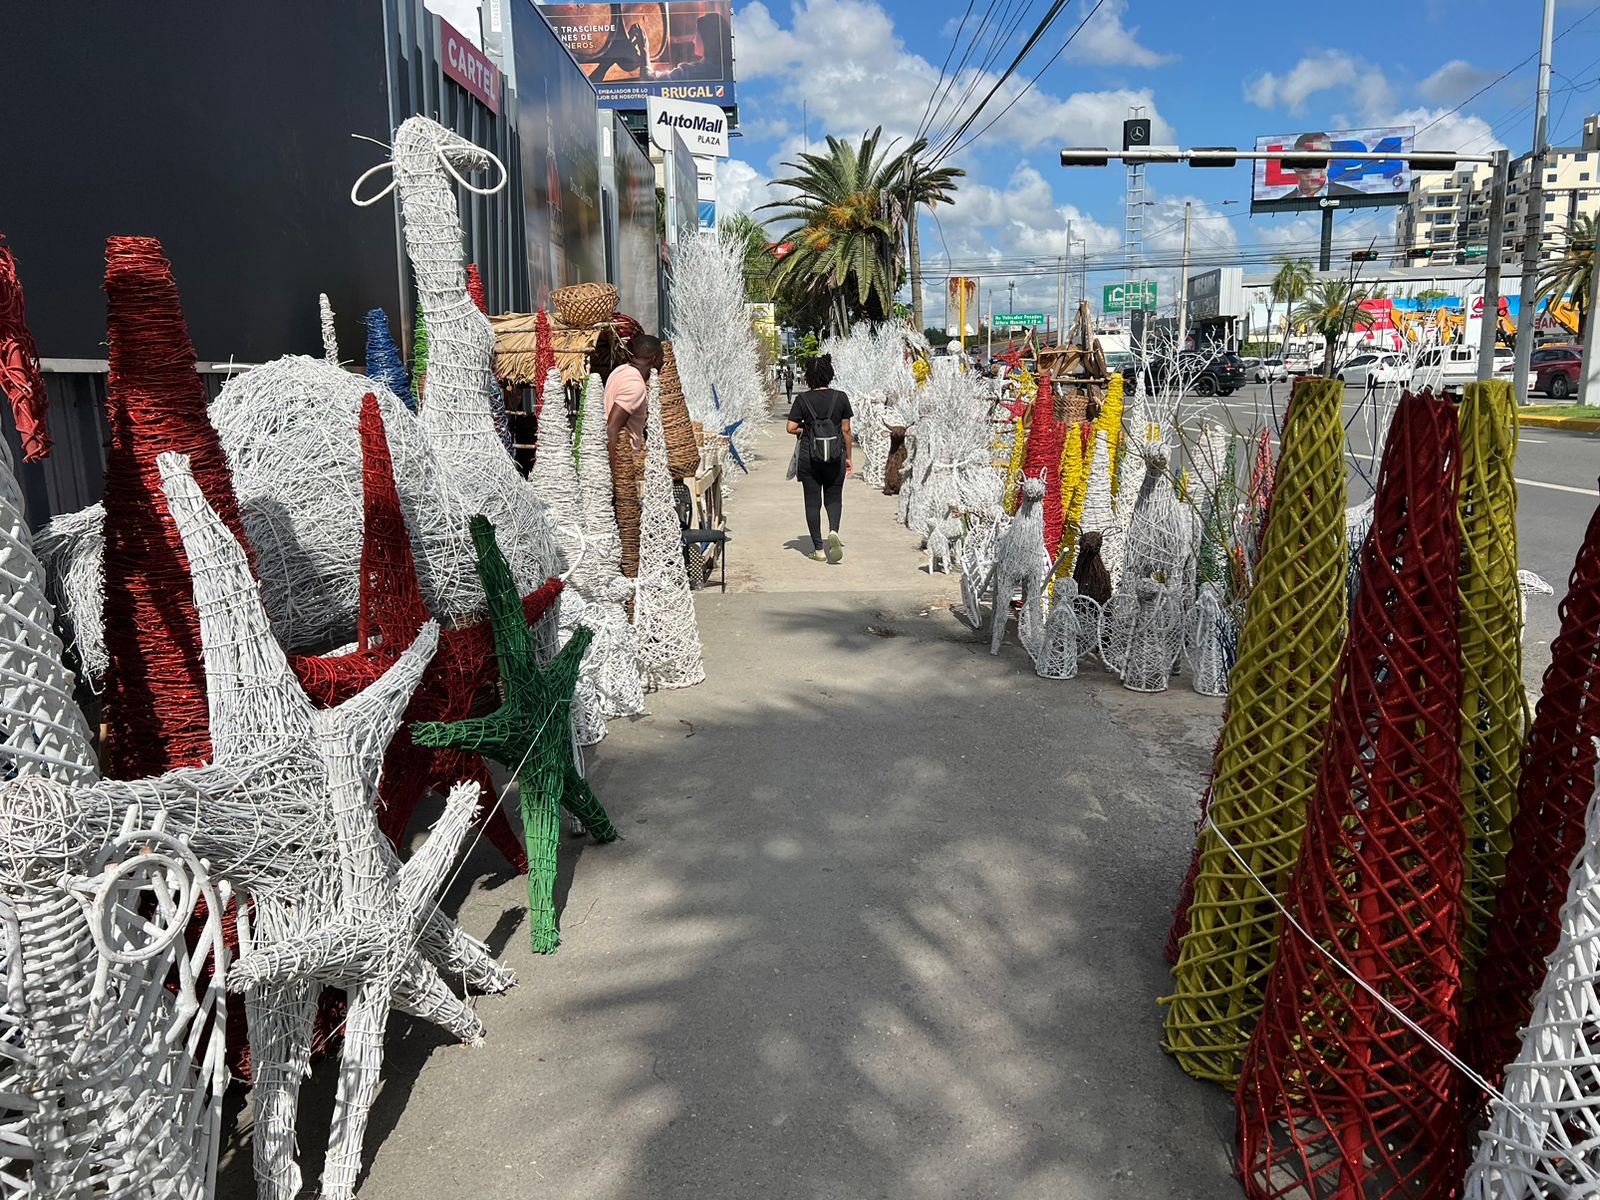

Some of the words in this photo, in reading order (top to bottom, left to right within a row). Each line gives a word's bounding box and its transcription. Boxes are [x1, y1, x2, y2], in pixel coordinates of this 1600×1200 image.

[561, 24, 616, 33] TRASCIENDE
[448, 38, 496, 101] CARTEL
[661, 86, 714, 98] BRUGAL
[657, 110, 723, 133] AutoMall
[697, 135, 720, 146] PLAZA
